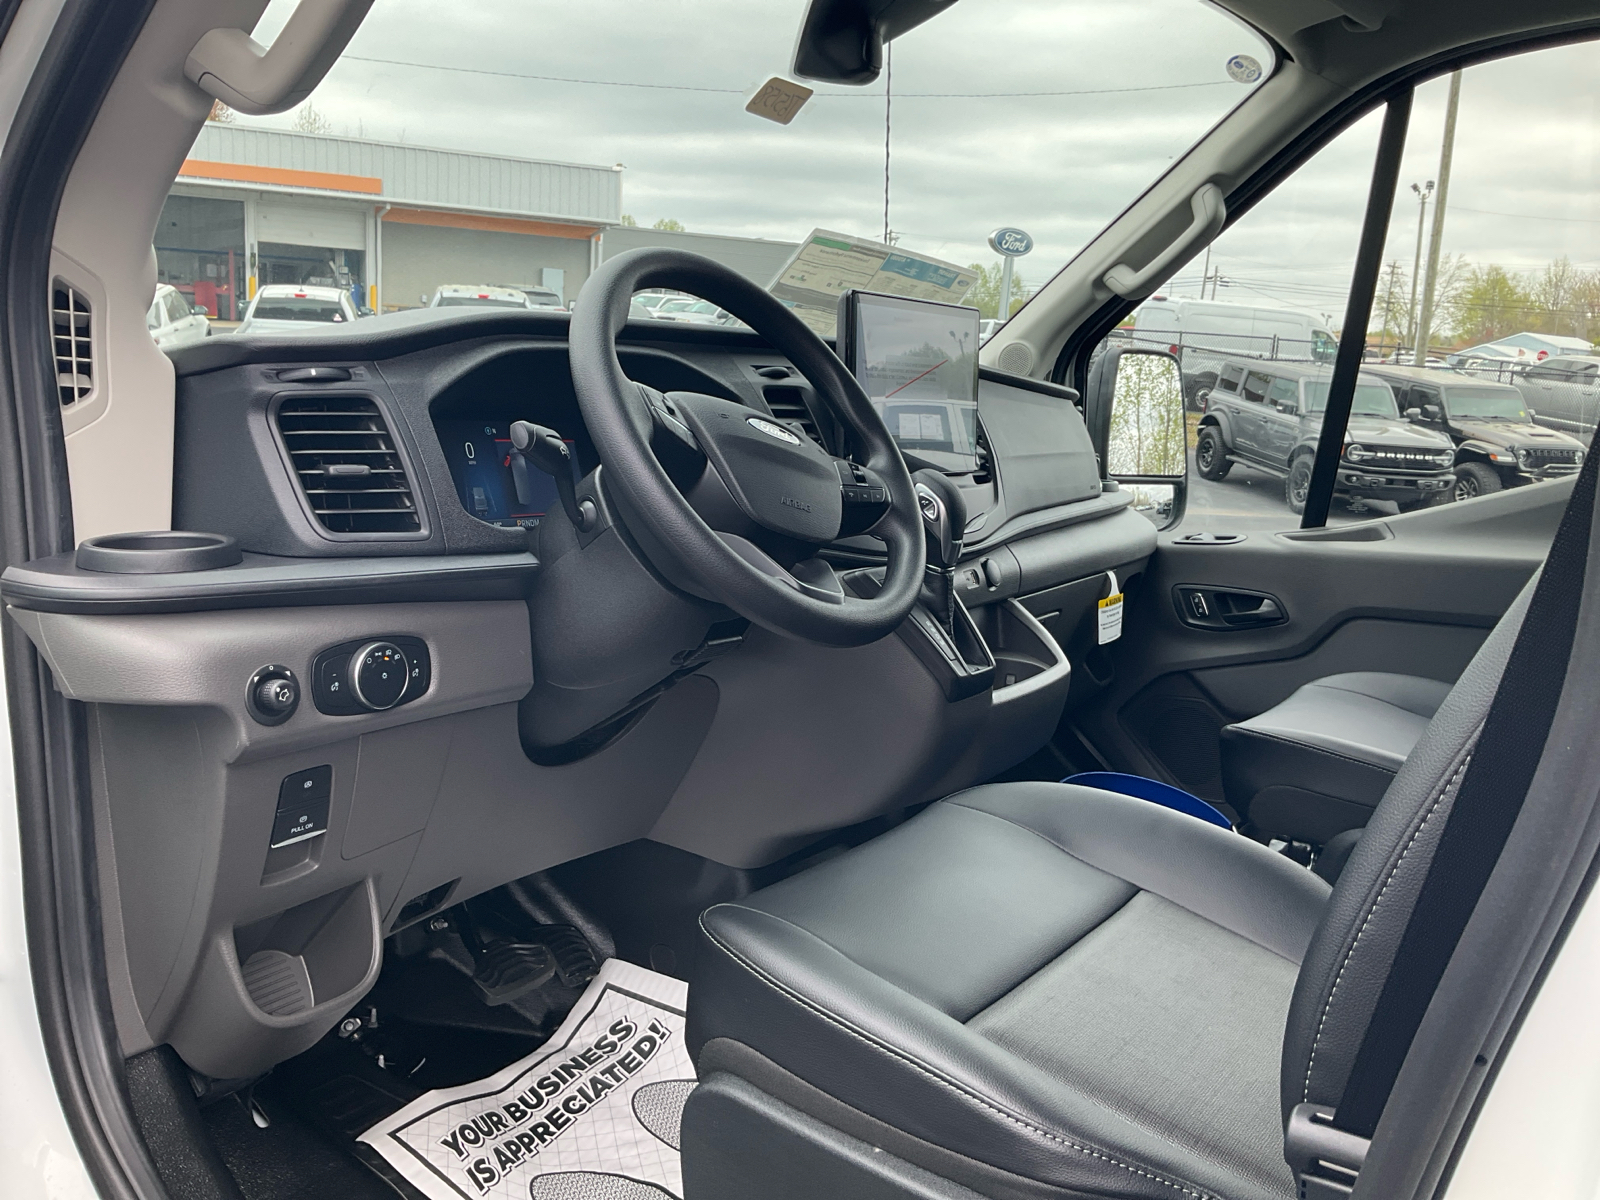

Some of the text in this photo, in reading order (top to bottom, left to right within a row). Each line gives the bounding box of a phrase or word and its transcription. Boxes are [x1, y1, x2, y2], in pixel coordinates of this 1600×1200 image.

[1002, 231, 1027, 251] Ford
[465, 442, 475, 459] 0
[1376, 452, 1433, 461] BRONCO
[780, 496, 811, 513] AIRBAG
[290, 825, 304, 834] PULL
[440, 1016, 637, 1160] YOUR BUSINESS
[465, 1017, 671, 1196] IS APPRECIATED!
